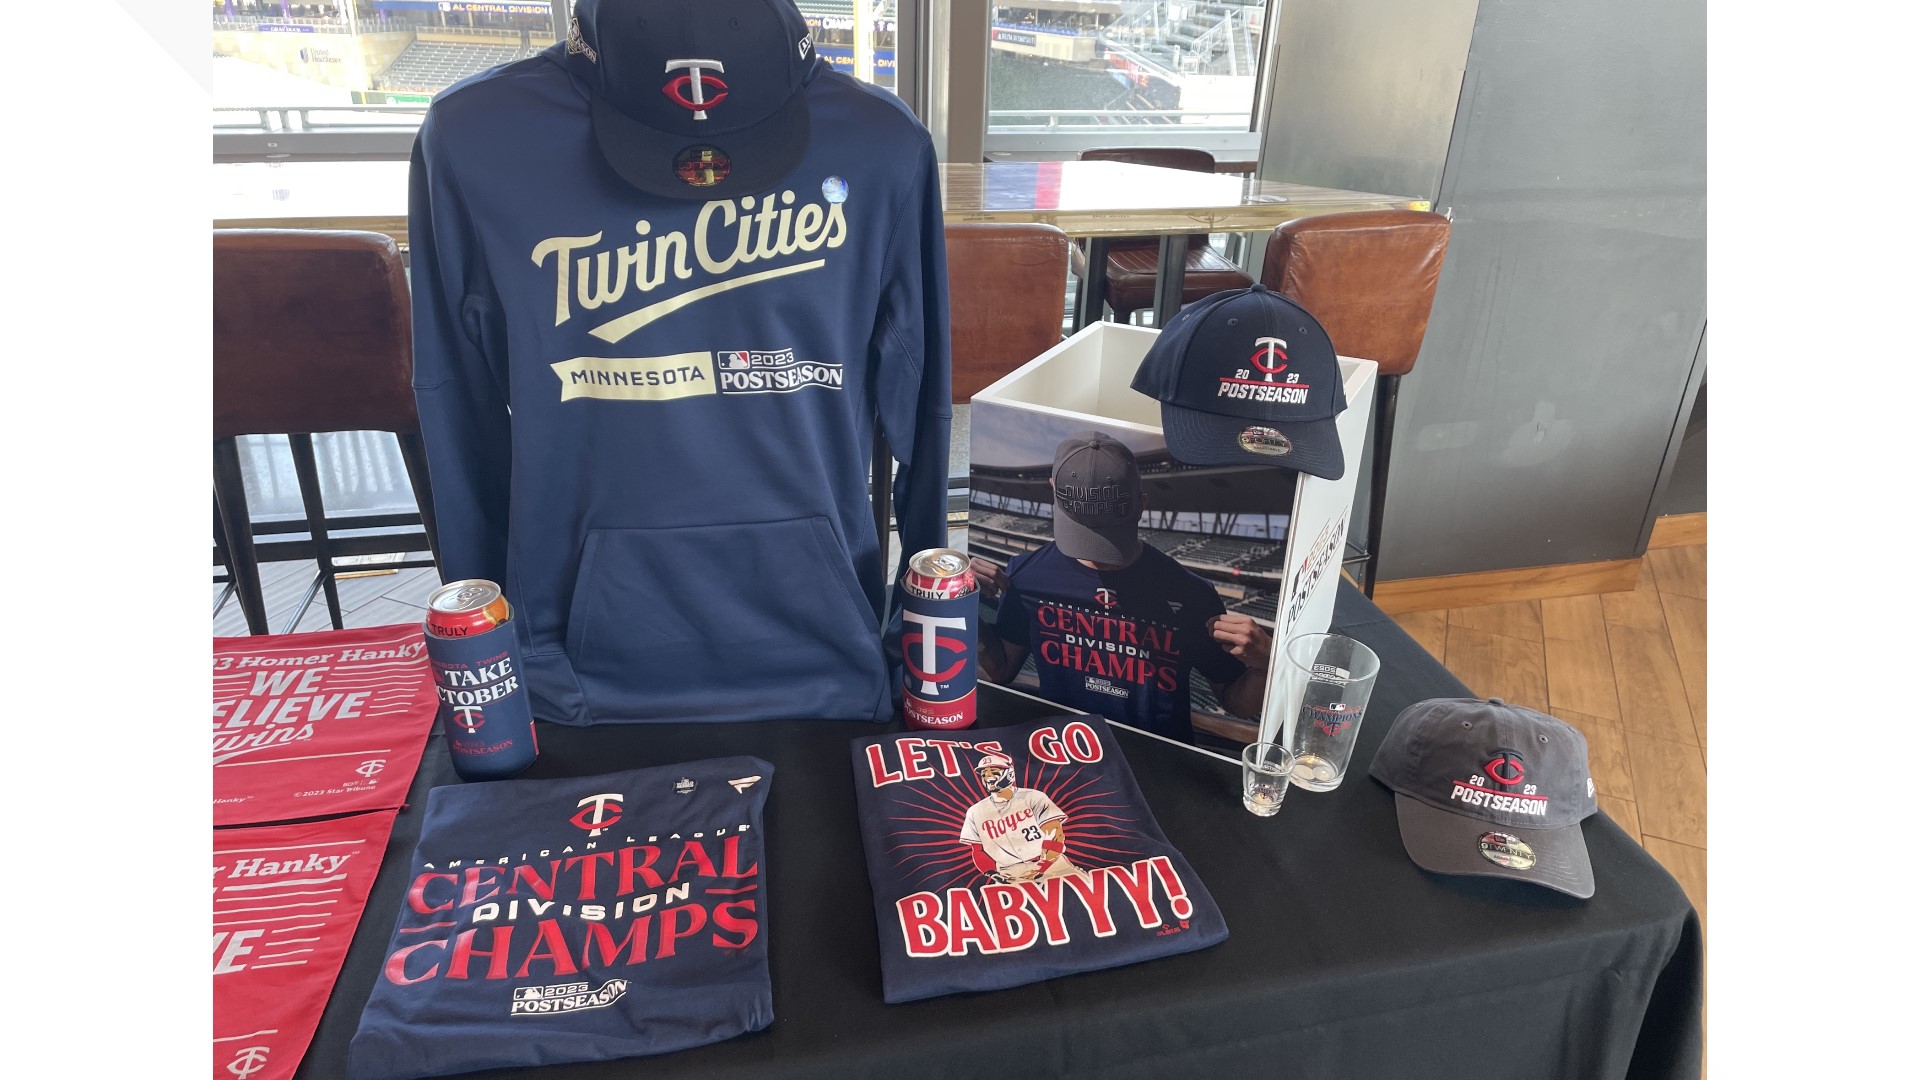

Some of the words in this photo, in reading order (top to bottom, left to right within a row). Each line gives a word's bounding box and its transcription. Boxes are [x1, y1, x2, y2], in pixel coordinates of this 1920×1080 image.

[466, 4, 507, 13] CENTRAL
[509, 6, 547, 14] DIVISION
[531, 219, 693, 327] Twin
[694, 189, 847, 274] Cities
[751, 352, 794, 366] 2023
[570, 365, 706, 386] MINNESOTA
[720, 365, 843, 389] POSTSEASON
[1234, 368, 1250, 379] 20
[1286, 372, 1300, 384] 23
[1217, 381, 1309, 404] POSTSEASON
[911, 586, 944, 600] TRULY
[1039, 599, 1109, 616] AMERICAN
[431, 624, 468, 637] TRULY
[1037, 605, 1180, 656] CENTRAL
[236, 652, 335, 669] Homer
[336, 641, 426, 664] Hanky
[1065, 633, 1150, 660] DIVISION
[444, 656, 513, 687] TAKE
[1040, 640, 1179, 692] CHAMPS
[249, 667, 330, 697] WE
[436, 675, 519, 706] CTOBER
[1085, 682, 1129, 697] POSTSEASON
[213, 691, 372, 729] ELIEVE
[866, 737, 1013, 788] LET'S
[1028, 721, 1104, 765] GO
[346, 785, 376, 793] Tribune
[1469, 774, 1485, 787] 20
[1523, 783, 1538, 796] 23
[1450, 785, 1548, 816] POSTSEASON
[981, 808, 1034, 840] Royce
[1021, 825, 1042, 842] 23
[227, 853, 351, 879] Hanky
[424, 841, 597, 869] AMERICAN
[408, 835, 758, 915] CENTRAL
[472, 882, 690, 923] DIVISION
[896, 855, 1194, 958] BABYYY!
[384, 899, 758, 987] CHAMPS
[511, 980, 628, 1013] POSTSEASON
[544, 984, 589, 997] 2023
